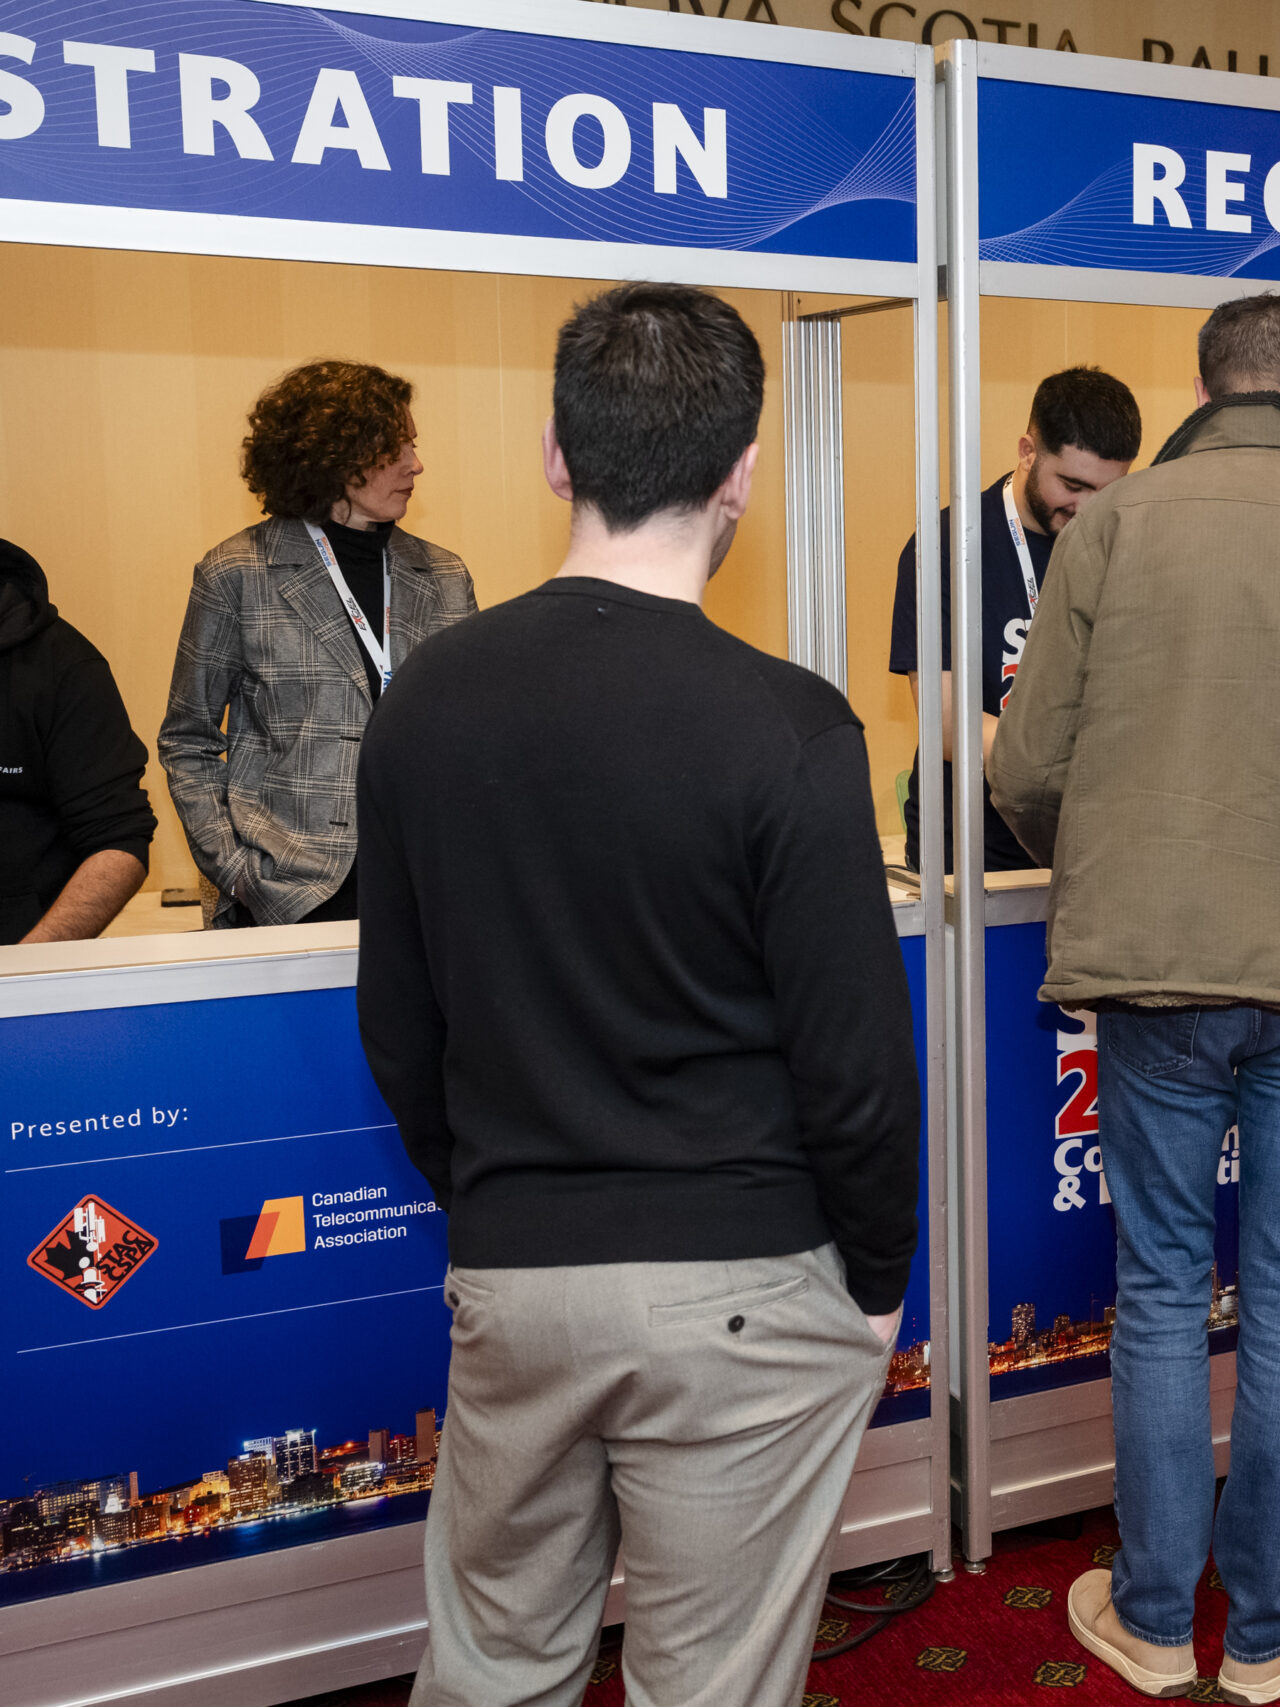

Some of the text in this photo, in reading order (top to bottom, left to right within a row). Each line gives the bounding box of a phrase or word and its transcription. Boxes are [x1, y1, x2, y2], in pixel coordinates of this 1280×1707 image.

[315, 538, 332, 567] SEGUIN
[11, 1106, 188, 1141] Presented by:
[312, 1186, 387, 1207] Canadian
[1053, 1175, 1087, 1212] &
[313, 1201, 442, 1228] Telecommunica
[96, 1230, 139, 1275] STAC
[314, 1225, 407, 1250] Association
[107, 1237, 155, 1281] CSPA
